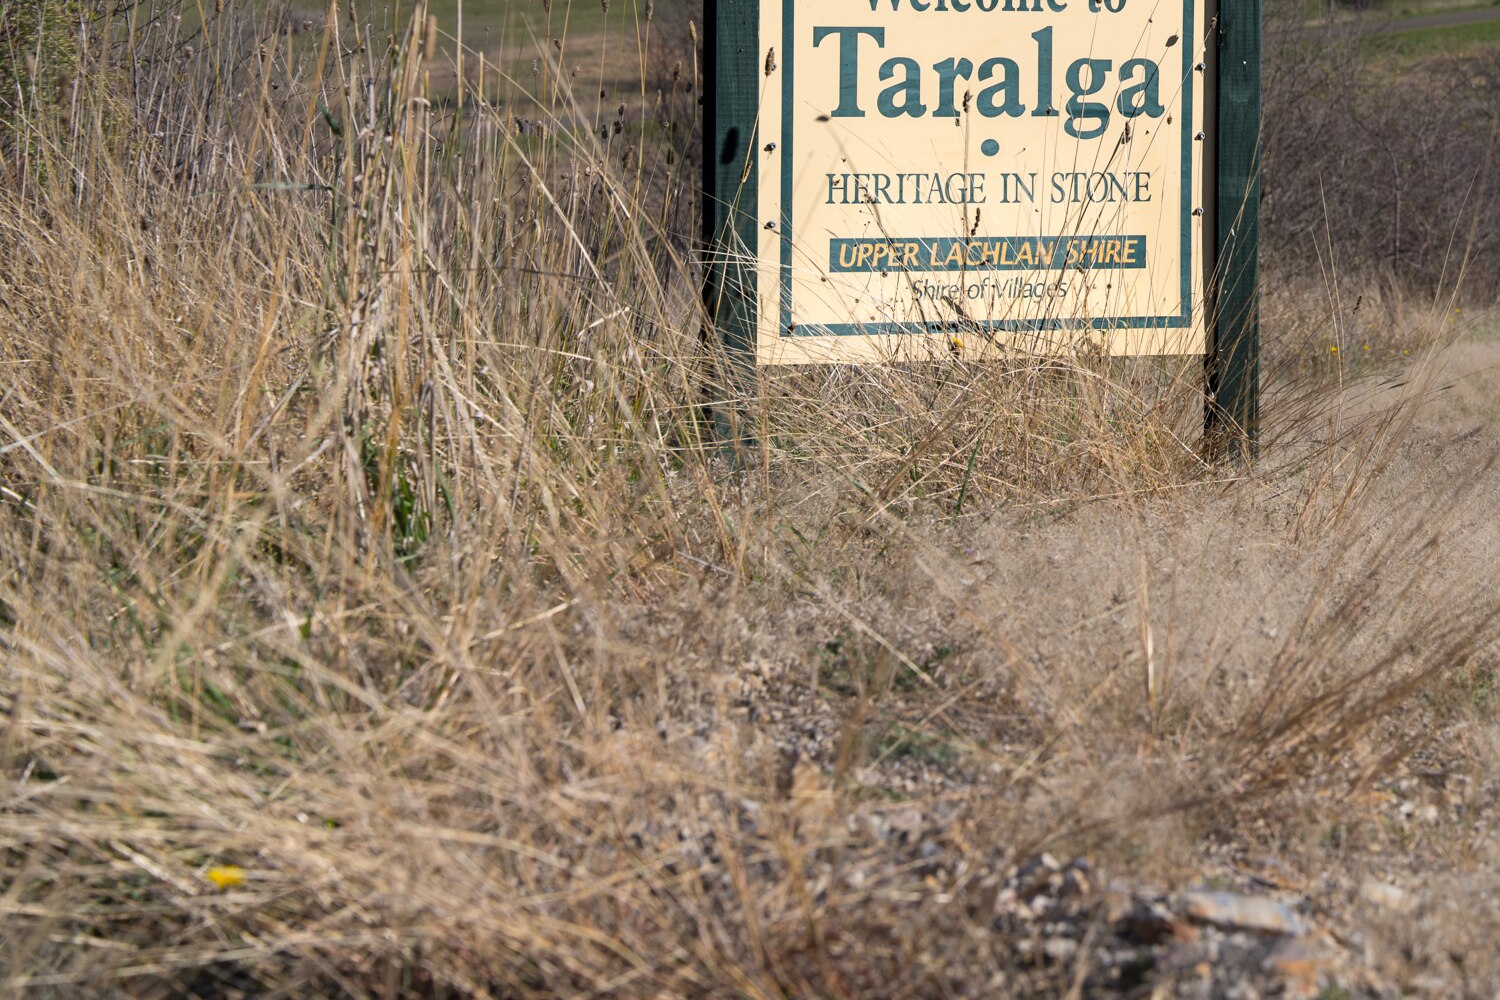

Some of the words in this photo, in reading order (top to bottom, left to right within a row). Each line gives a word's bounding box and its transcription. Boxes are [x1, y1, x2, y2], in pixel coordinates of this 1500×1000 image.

[813, 26, 1165, 140] Taralga
[825, 172, 986, 204] HERITAGE
[1000, 172, 1038, 204] IN
[1050, 172, 1152, 204] STONE
[839, 242, 919, 268] UPPER
[930, 241, 1054, 267] LACHLAN
[1066, 239, 1138, 264] SHIRE
[913, 278, 959, 300] Shire
[967, 277, 990, 300] of
[995, 277, 1068, 303] Villages
